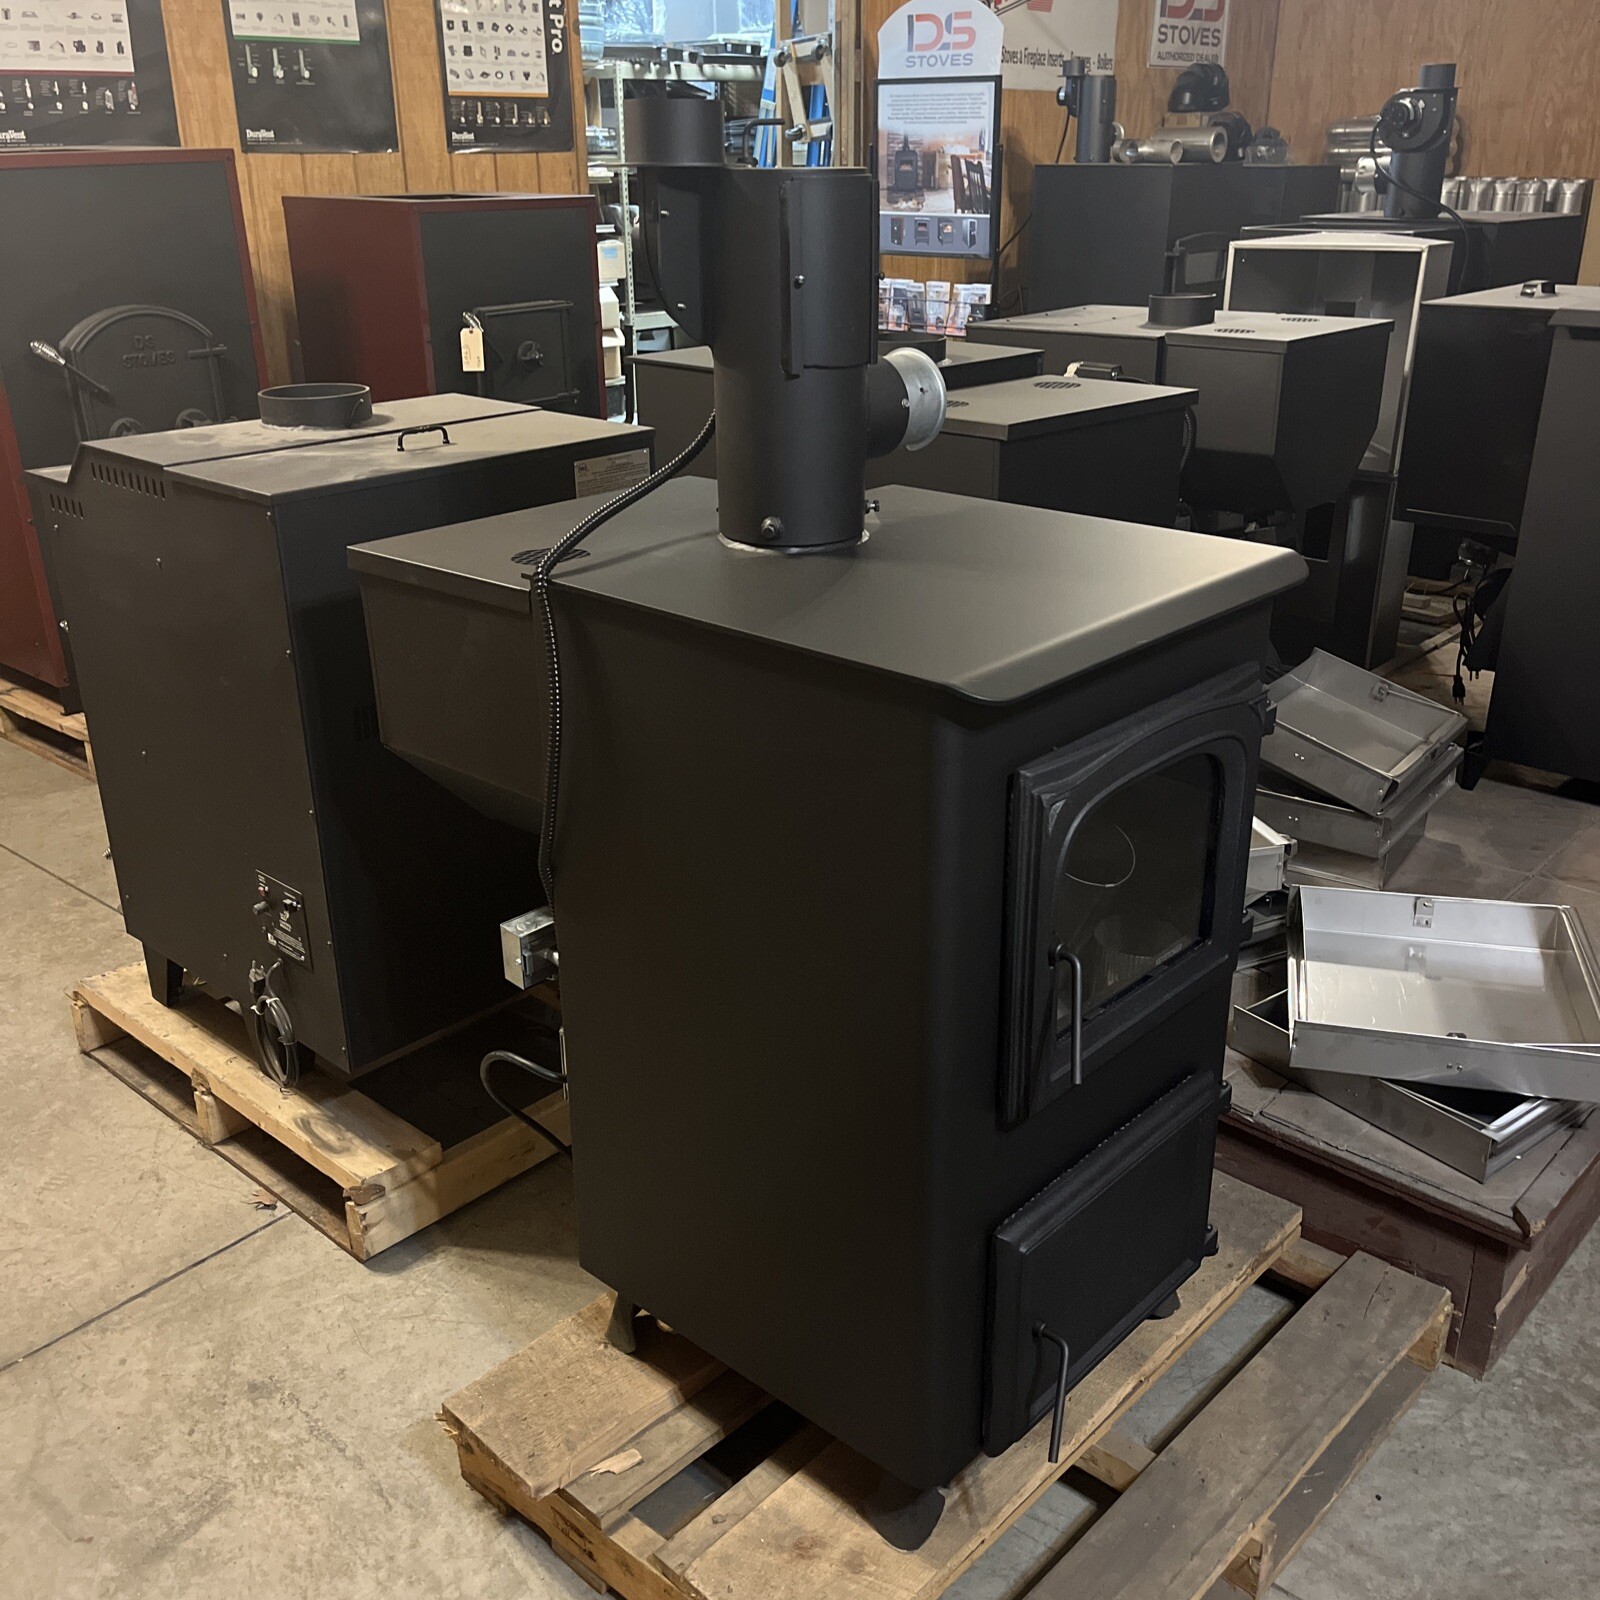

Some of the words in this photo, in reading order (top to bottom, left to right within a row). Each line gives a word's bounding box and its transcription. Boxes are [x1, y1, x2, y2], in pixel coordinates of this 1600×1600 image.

[550, 13, 565, 54] Pro
[907, 11, 977, 52] DS
[1158, 24, 1222, 48] STOVES
[905, 53, 974, 69] STOVES
[1001, 45, 1018, 64] Stoves
[1024, 47, 1046, 69] Fireplace
[1157, 51, 1195, 62] AUTHORIZED
[1196, 52, 1219, 64] DEALER
[122, 350, 176, 369] STOVES
